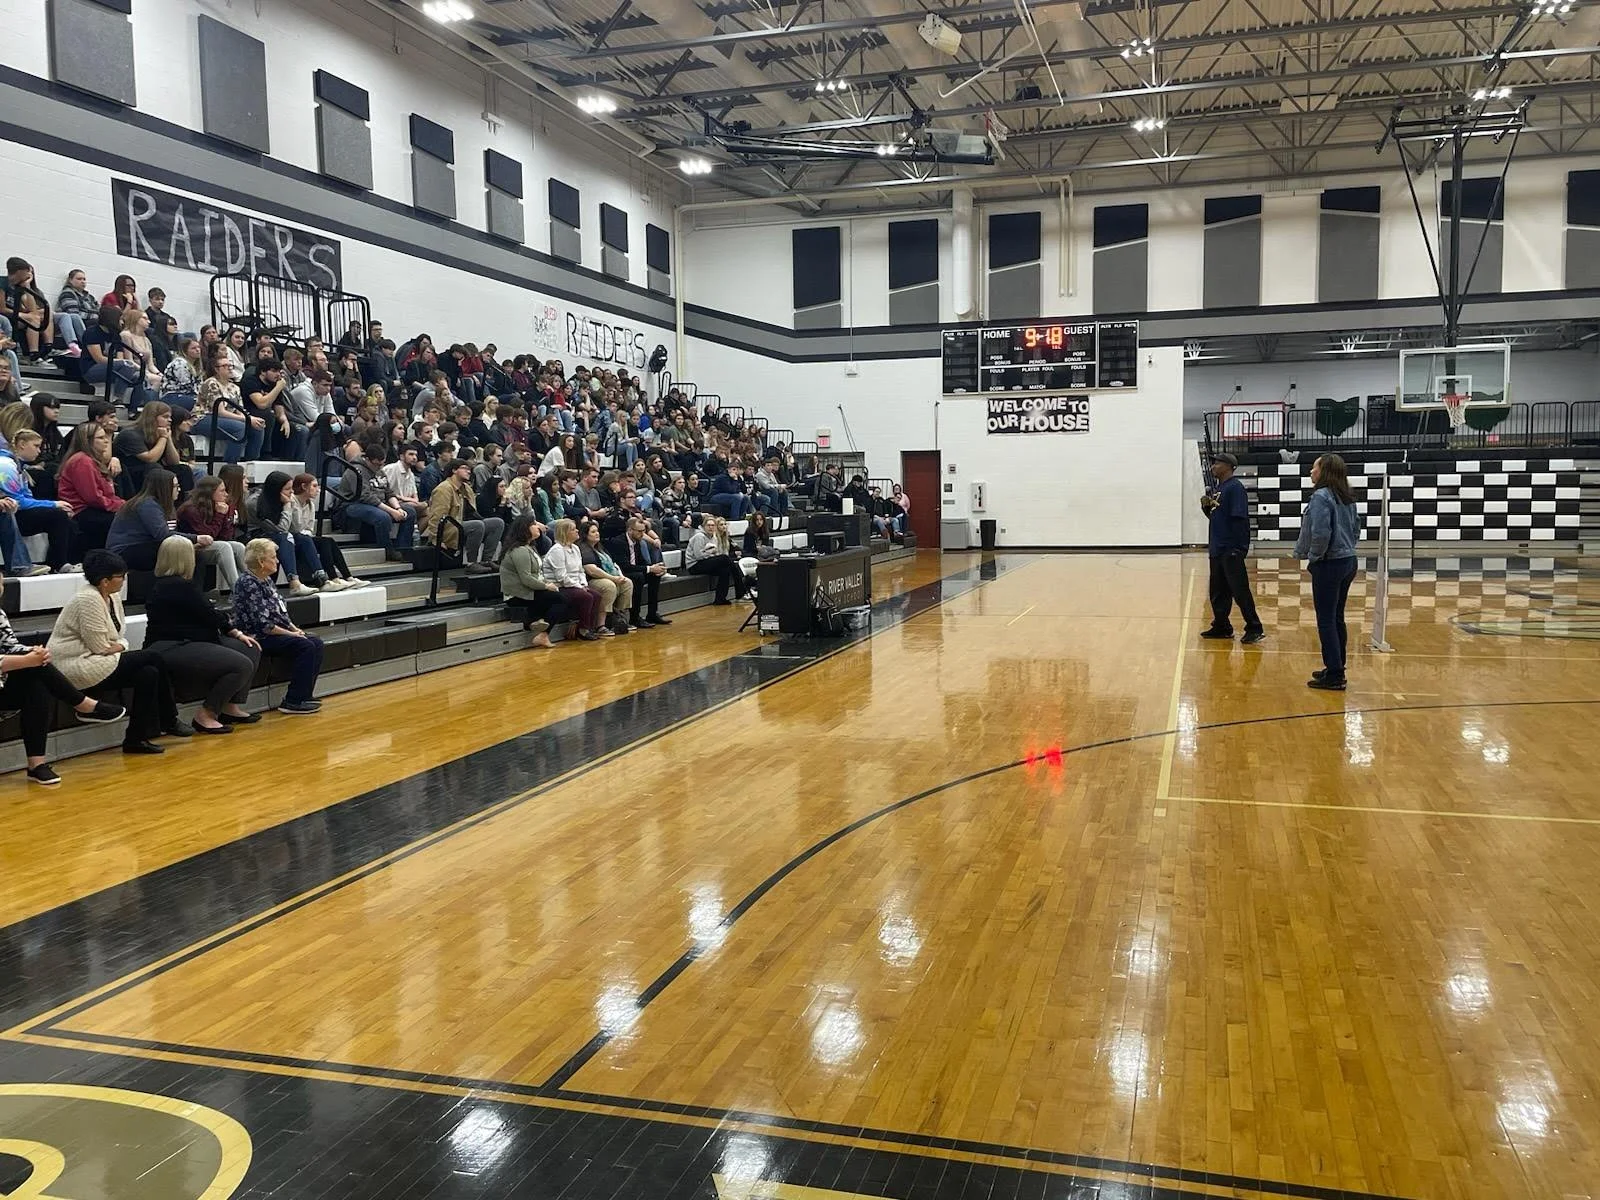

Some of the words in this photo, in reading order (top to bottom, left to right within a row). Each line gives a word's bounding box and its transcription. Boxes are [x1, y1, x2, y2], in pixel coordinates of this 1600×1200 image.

[127, 188, 337, 291] RAIDERS
[983, 330, 1011, 339] HOME
[1063, 326, 1094, 335] GUEST
[566, 312, 646, 369] RAIDERS
[989, 397, 1067, 413] WELCOME
[1068, 400, 1089, 414] TO
[987, 414, 1019, 431] OUR
[1019, 415, 1088, 431] HOUSE
[828, 577, 845, 595] RIVER
[844, 572, 864, 590] VALLEY
